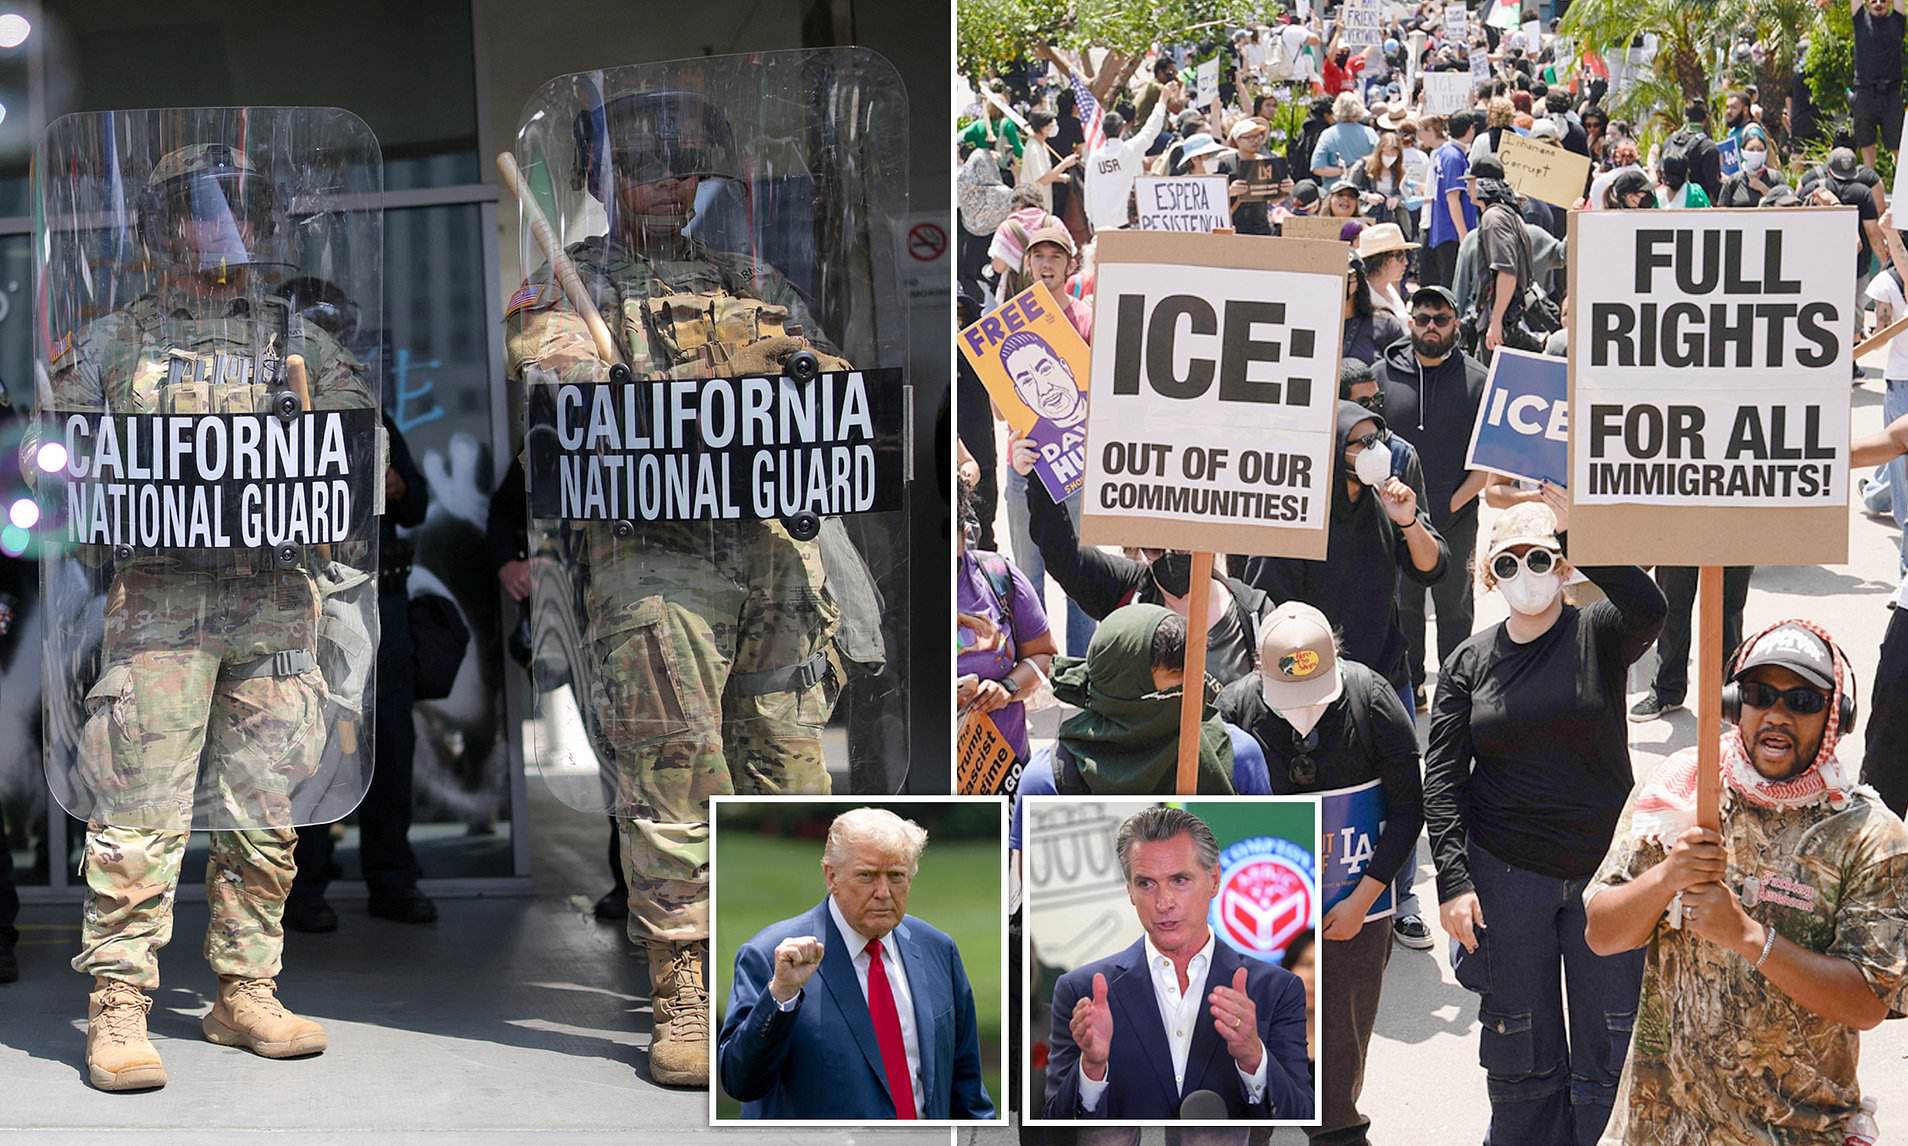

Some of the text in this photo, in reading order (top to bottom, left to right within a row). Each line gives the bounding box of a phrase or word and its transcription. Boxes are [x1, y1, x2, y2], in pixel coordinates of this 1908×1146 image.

[1098, 158, 1121, 175] USA
[1500, 150, 1551, 177] Corrupt
[1154, 182, 1210, 211] ESPERA
[1634, 229, 1801, 295] FULL
[964, 291, 1045, 357] FREE
[1113, 294, 1316, 407] ICE:
[1591, 302, 1840, 368] RIGHTS
[556, 372, 874, 451] CALIFORNIA
[1487, 387, 1568, 442] ICE
[1588, 403, 1836, 460] FOR ALL
[65, 413, 350, 481] CALIFORNIA
[1102, 440, 1313, 489] OUT OF OUR
[560, 444, 876, 520] NATIONAL GUARD
[1100, 481, 1309, 522] COMMUNITIES!
[1588, 463, 1831, 497] IMMIGRANTS!
[68, 479, 350, 549] NATIONAL GUARD
[960, 730, 997, 795] ascist
[1004, 763, 1022, 792] GO
[1340, 826, 1375, 874] LA
